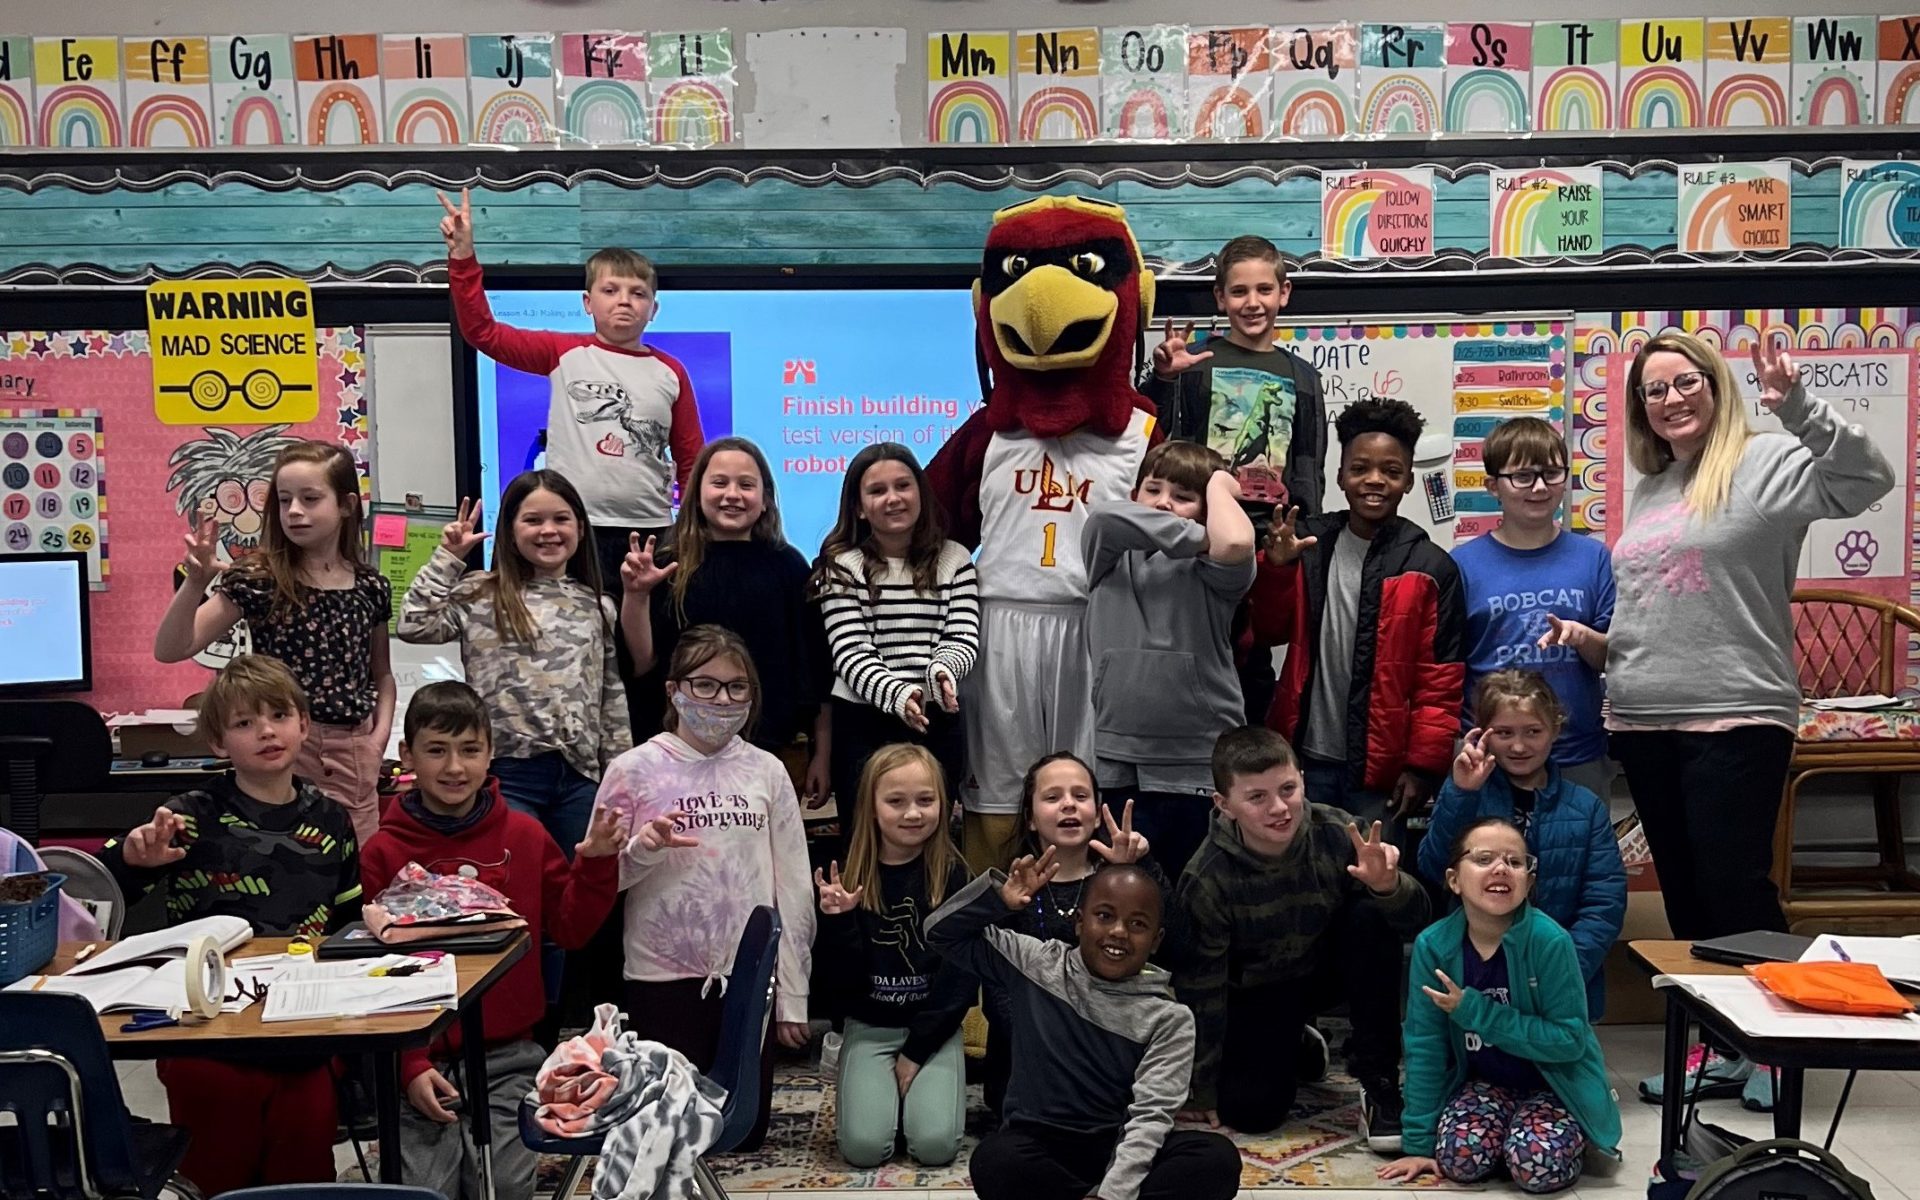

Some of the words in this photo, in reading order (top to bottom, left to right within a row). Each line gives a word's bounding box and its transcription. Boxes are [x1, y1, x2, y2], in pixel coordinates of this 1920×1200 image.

[1381, 25, 1424, 68] Rr
[1470, 23, 1508, 67] Ss
[1561, 23, 1594, 66] Tt
[1642, 22, 1682, 63] Uu
[1730, 20, 1769, 62] Vv
[1808, 18, 1862, 61] Ww
[62, 39, 93, 81] Ee
[150, 39, 187, 82] Ff
[315, 36, 359, 79] Hh
[496, 35, 524, 88] Jj
[583, 34, 623, 78] Kk
[679, 34, 702, 77] Ll
[942, 33, 995, 78] Mm
[1035, 32, 1079, 75] Nn
[1121, 30, 1164, 73] Oo
[1208, 29, 1248, 80] Pp
[1289, 28, 1339, 80] Qq
[230, 37, 271, 90] Gg
[1326, 177, 1356, 190] RULE
[1361, 179, 1374, 190] #1
[1496, 177, 1527, 191] RULE
[1532, 178, 1548, 190] #2
[1684, 170, 1715, 185] RULE
[1720, 172, 1736, 184] #3
[1847, 168, 1879, 183] RULE
[1558, 185, 1592, 201] RAISE
[1748, 179, 1774, 195] MAKE
[1385, 191, 1420, 206] FOLLOW
[1377, 214, 1428, 229] DIRECTIONS
[1561, 211, 1588, 228] YOUR
[1739, 203, 1785, 222] SMART
[1380, 236, 1426, 253] QUICKLY
[1558, 235, 1592, 251] HAND
[1743, 229, 1780, 245] CHOICES
[150, 290, 307, 320] WARNING
[162, 335, 210, 356] MAD
[221, 333, 305, 356] SCIENCE
[0, 374, 34, 396] ary
[1498, 369, 1549, 381] Bathroom
[1800, 362, 1888, 387] OBCATS
[783, 396, 853, 415] Finish
[862, 396, 958, 418] building
[1499, 394, 1531, 406] Switch
[783, 425, 822, 444] test
[829, 424, 904, 444] version
[913, 424, 933, 444] of
[76, 440, 86, 453] 5
[784, 454, 848, 473] robot
[42, 470, 54, 484] 11
[75, 468, 90, 484] 12
[1014, 452, 1094, 512] ULM
[10, 500, 24, 514] 17
[42, 497, 56, 512] 18
[76, 497, 90, 513] 19
[9, 528, 29, 543] 24
[42, 532, 63, 548] 25
[73, 531, 91, 545] 26
[1041, 522, 1057, 567] 1
[1488, 588, 1584, 618] BOBCAT
[1495, 644, 1580, 666] PRIDE
[672, 791, 722, 814] LOVE
[726, 794, 748, 810] IS
[673, 810, 766, 832] STOPPABLE
[872, 975, 889, 986] DA
